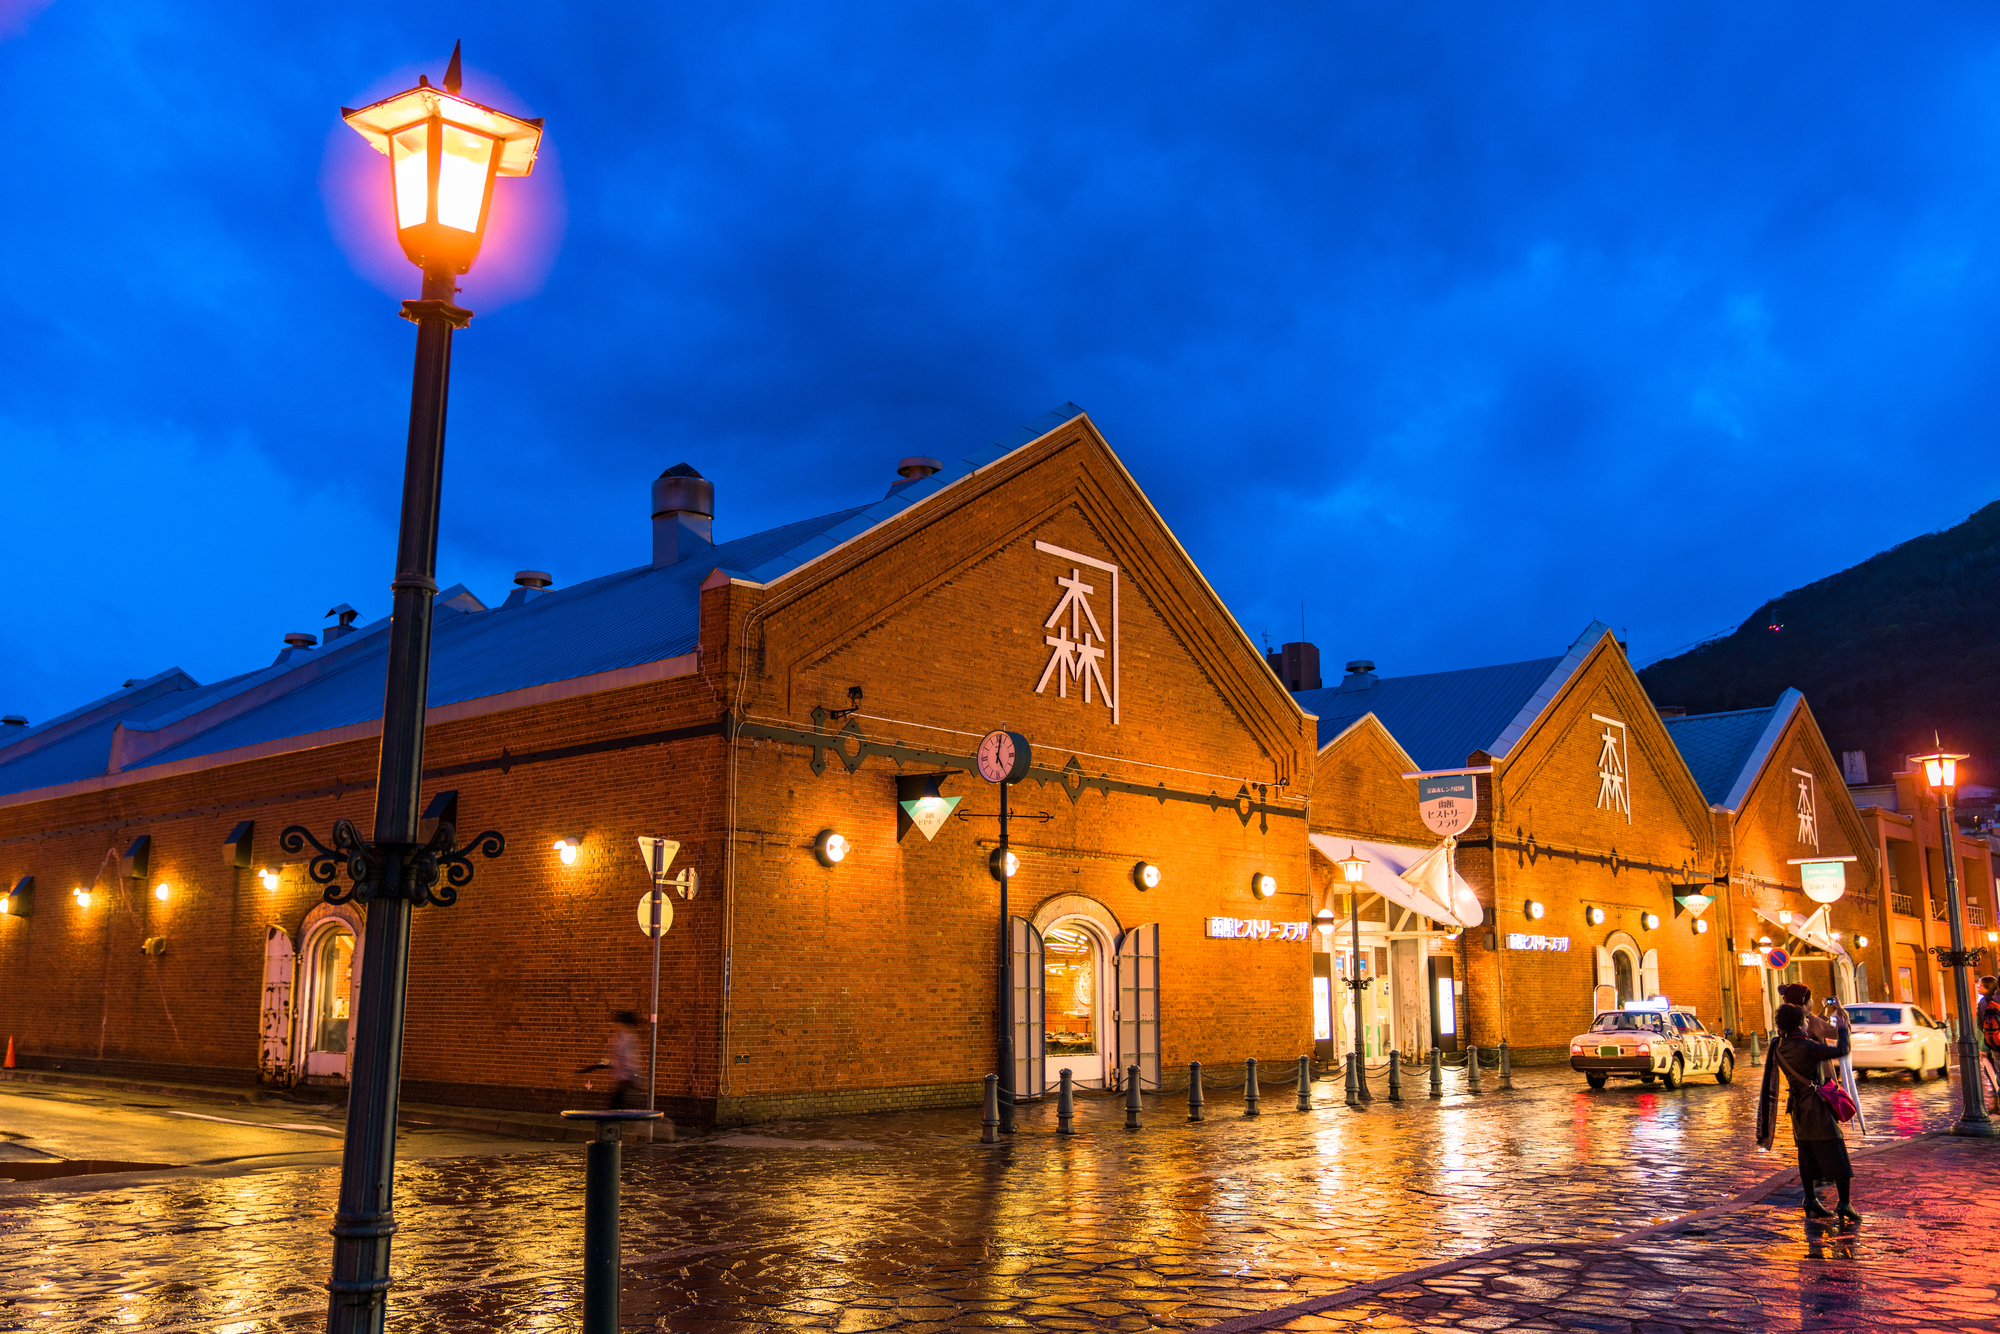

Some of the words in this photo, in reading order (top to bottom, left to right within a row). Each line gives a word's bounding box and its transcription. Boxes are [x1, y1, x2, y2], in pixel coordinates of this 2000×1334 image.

[1427, 809, 1466, 819] ヒストリー
